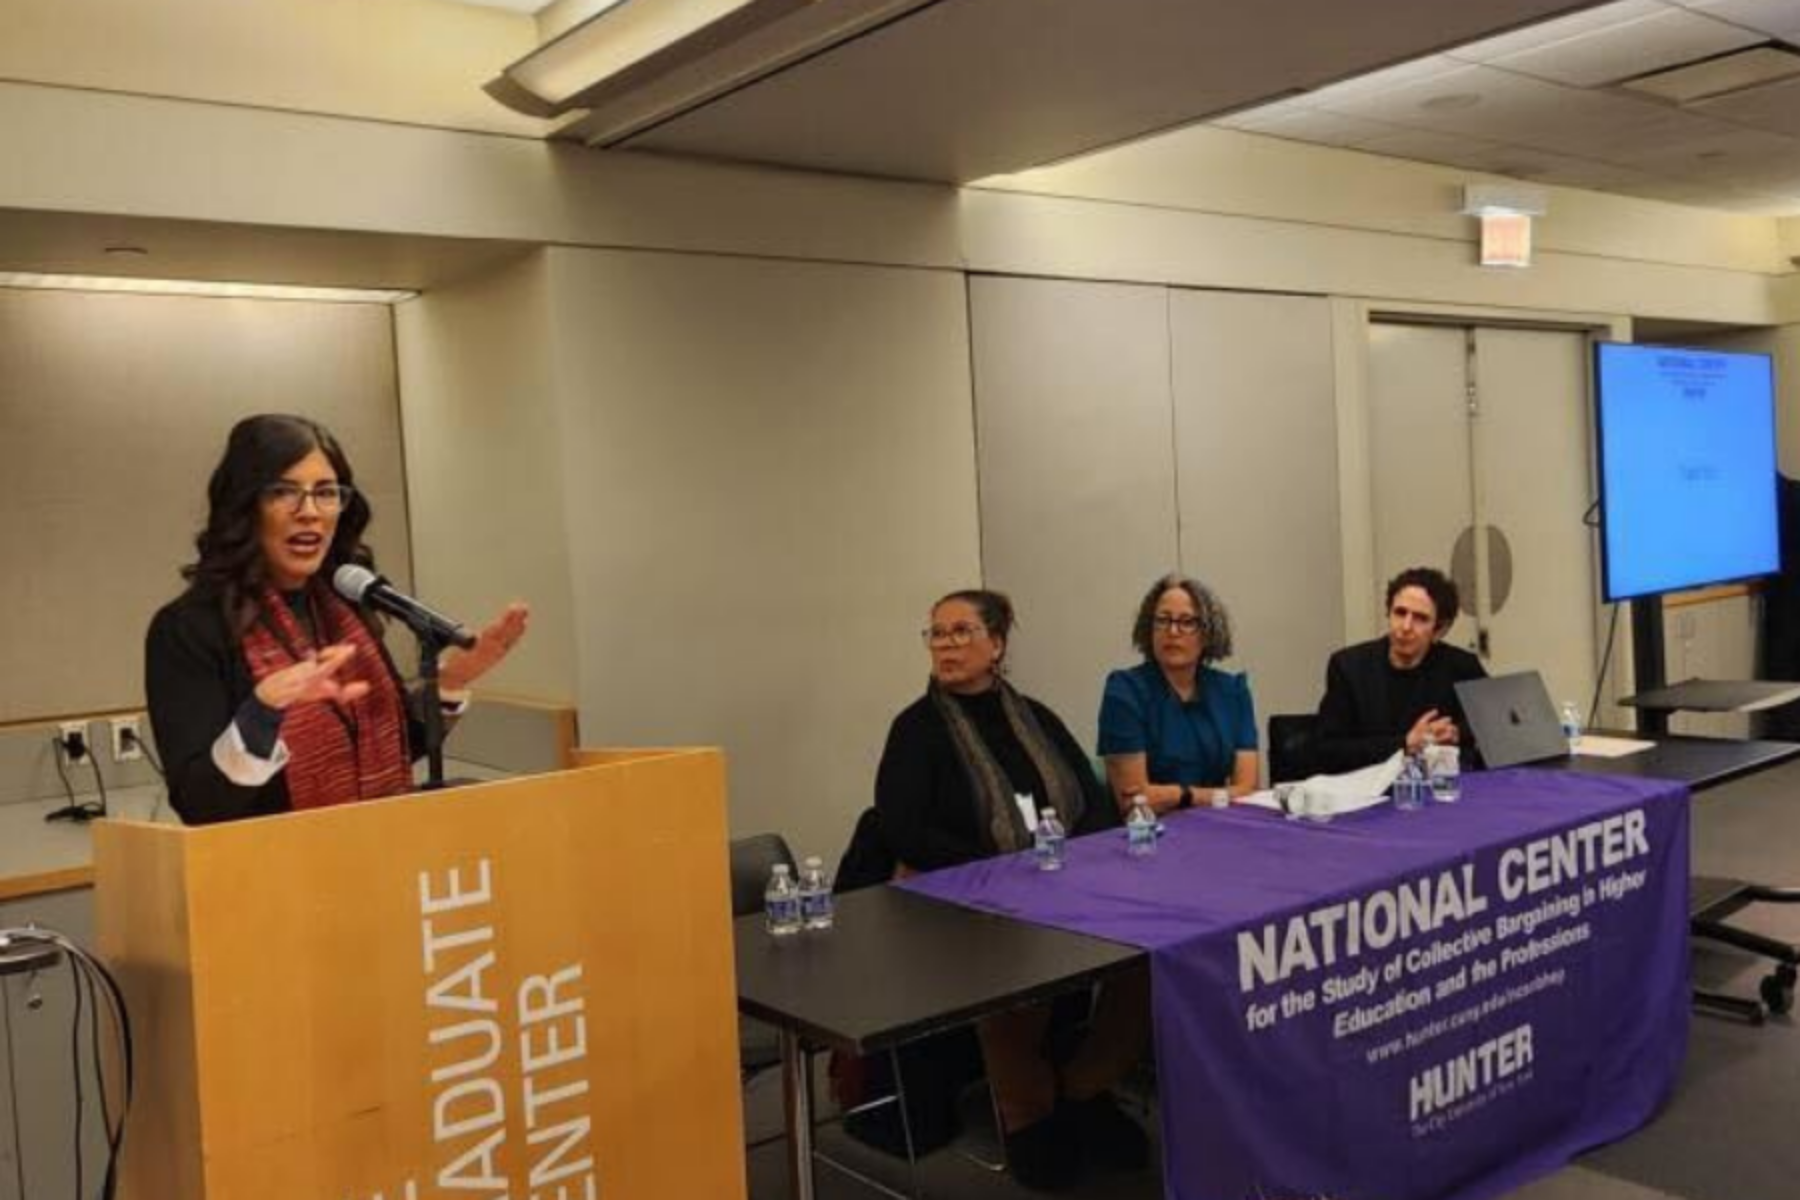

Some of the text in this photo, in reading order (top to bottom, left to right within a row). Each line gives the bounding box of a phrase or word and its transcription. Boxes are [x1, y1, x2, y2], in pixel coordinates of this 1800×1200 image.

[1238, 809, 1649, 992] NATIONAL CENTER
[1246, 869, 1647, 1032] for the Study of Collective Bargaining in Higher
[1333, 921, 1592, 1039] Education and the Professions
[418, 858, 508, 1200] ADUATE
[1409, 1022, 1535, 1122] HUNTER
